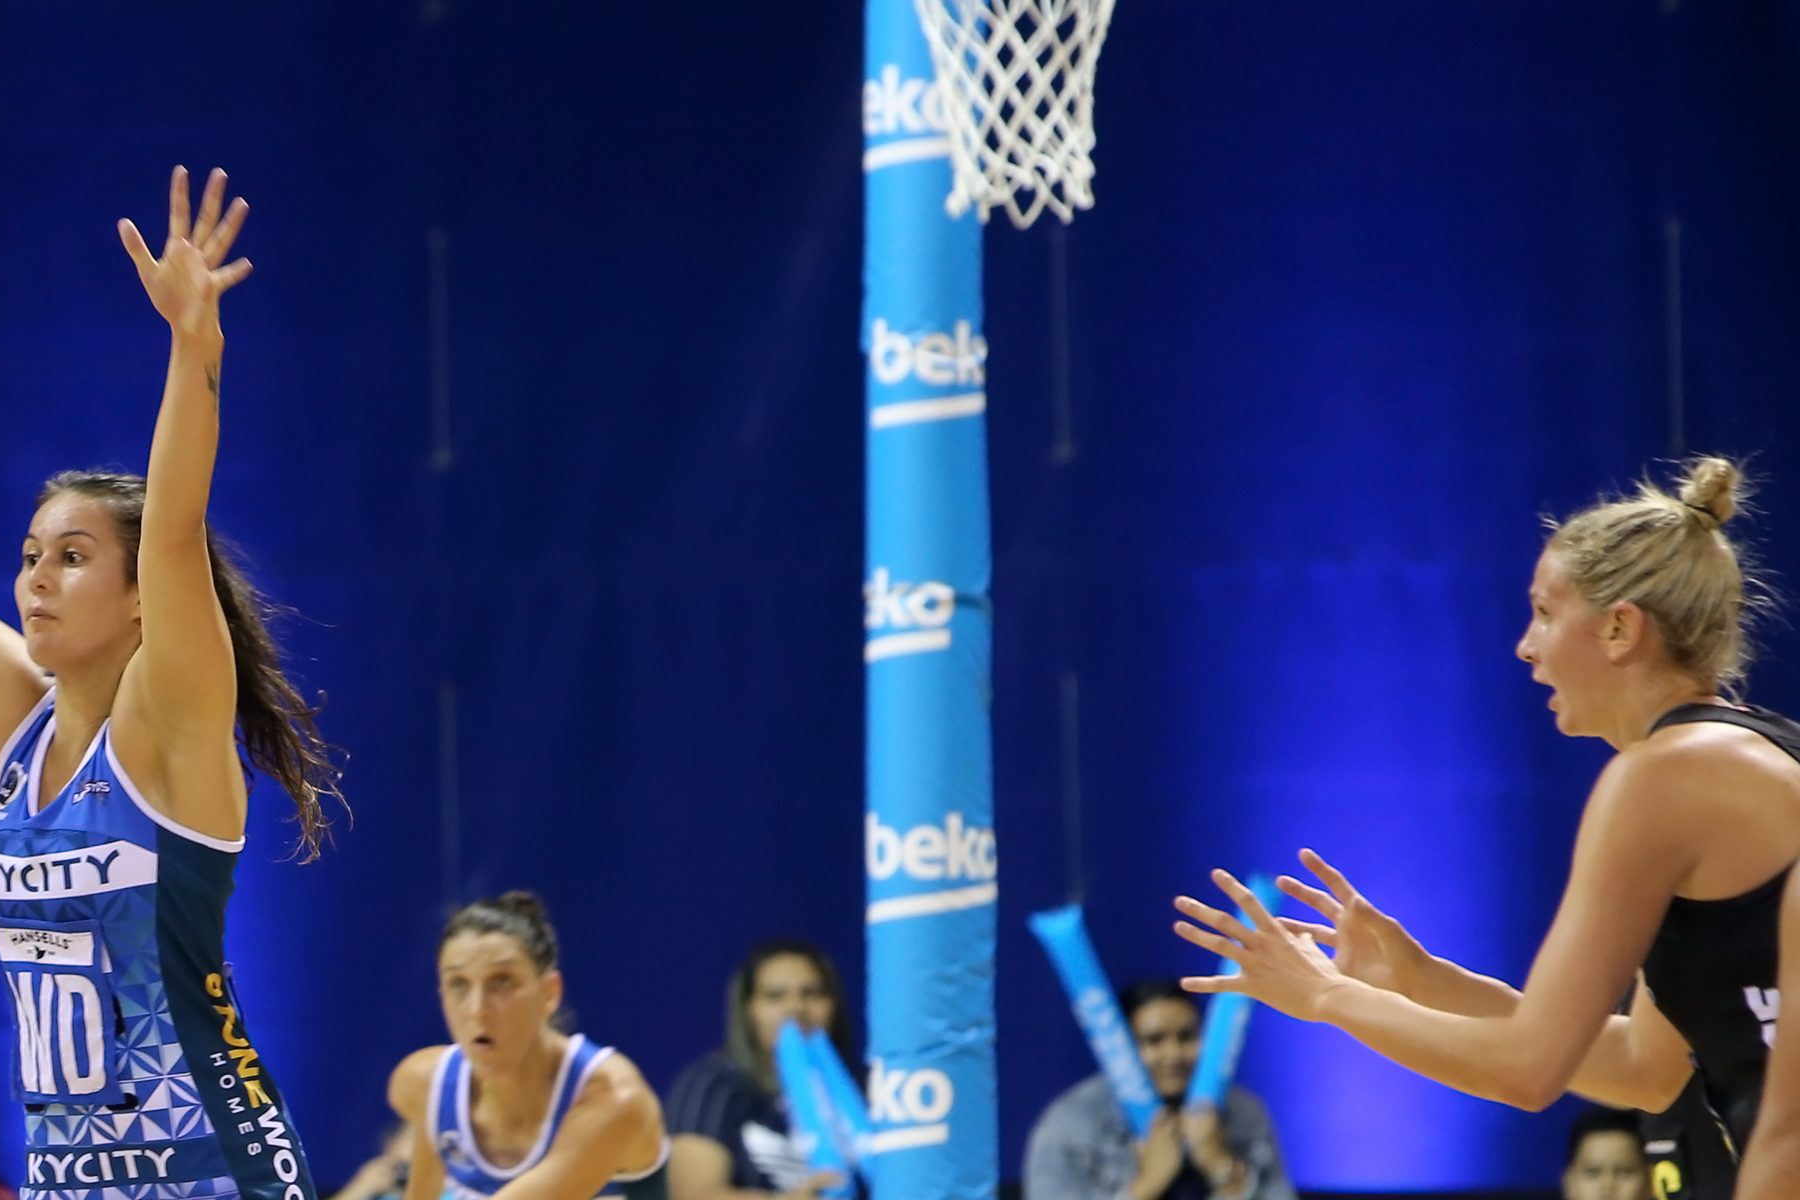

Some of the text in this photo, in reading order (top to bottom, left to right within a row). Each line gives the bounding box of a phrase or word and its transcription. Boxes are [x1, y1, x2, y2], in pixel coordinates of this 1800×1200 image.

[870, 317, 987, 386] bek
[863, 566, 955, 629] ko
[869, 1057, 953, 1123] ko
[27, 1147, 175, 1185] KYCITY
